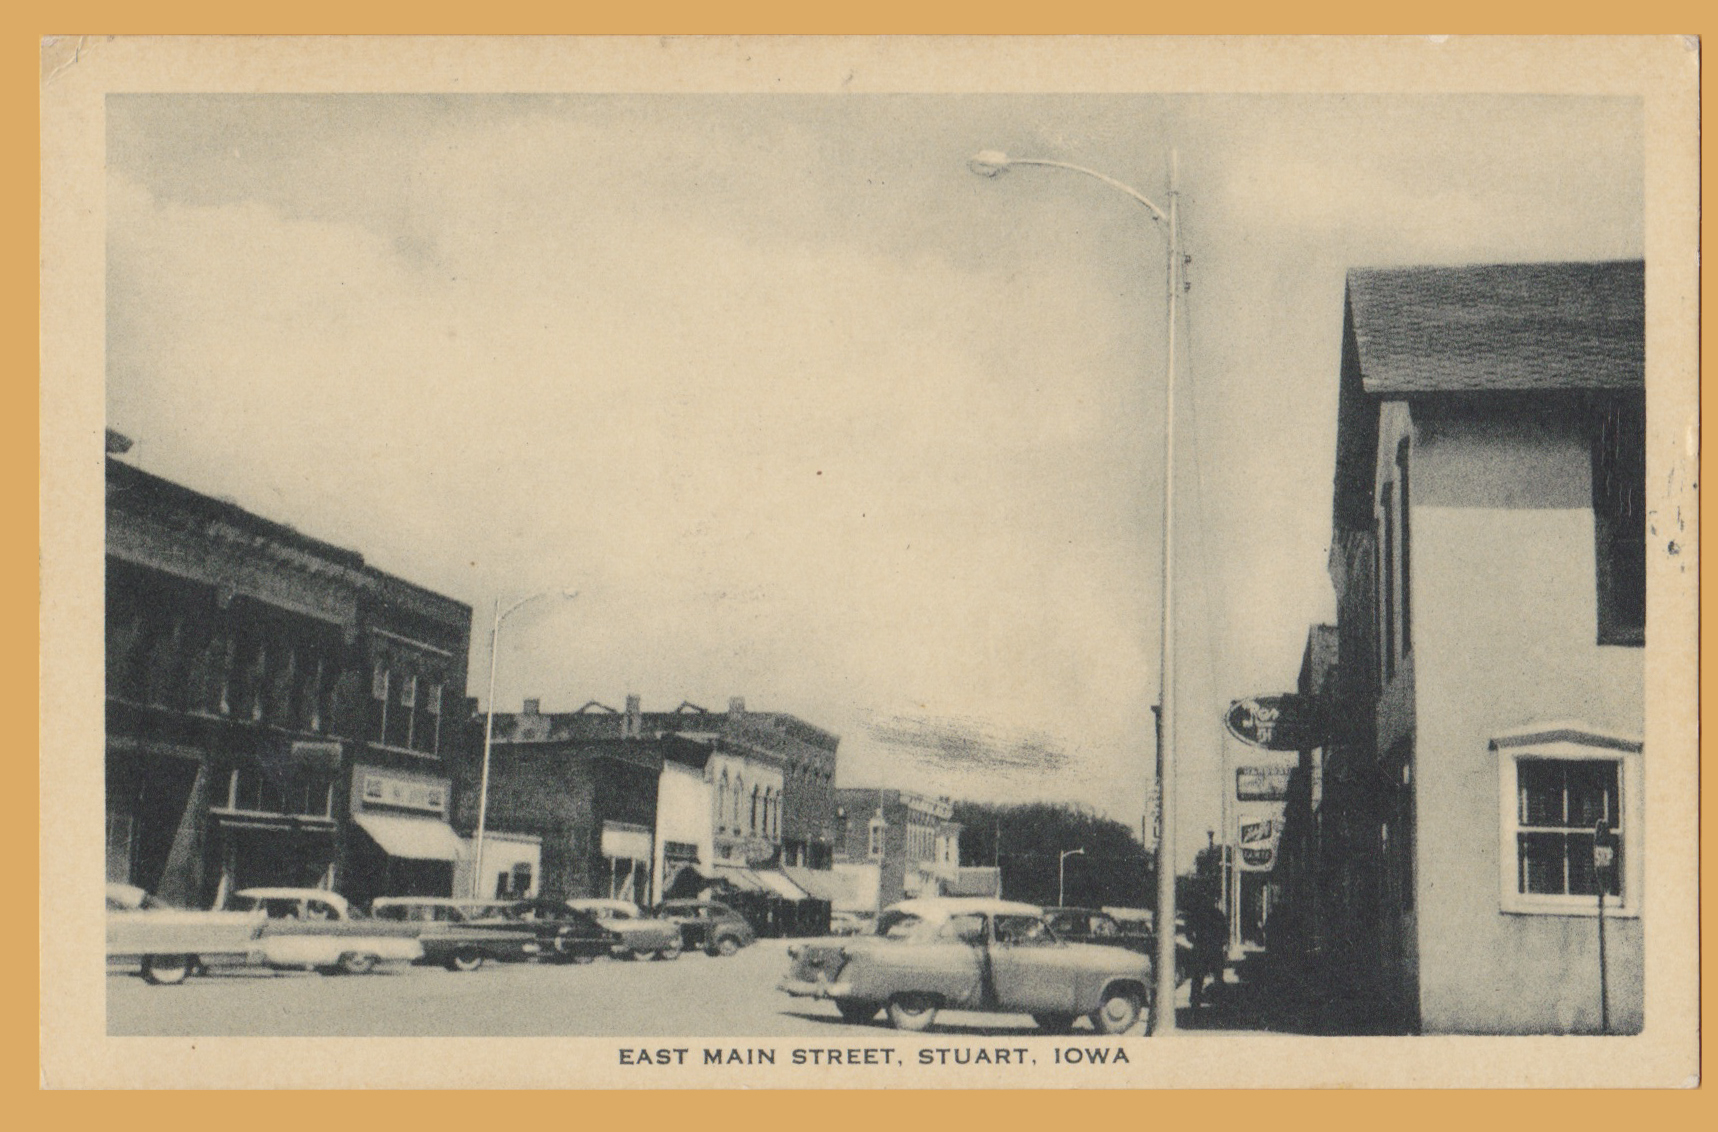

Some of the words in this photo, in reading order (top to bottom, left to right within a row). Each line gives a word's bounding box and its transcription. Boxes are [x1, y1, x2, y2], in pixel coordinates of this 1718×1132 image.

[619, 1048, 689, 1066] EAST
[703, 1048, 775, 1065] MAIN
[792, 1048, 904, 1068] STREET,
[918, 1048, 1037, 1068] STUART,
[1054, 1047, 1130, 1065] IOWA
